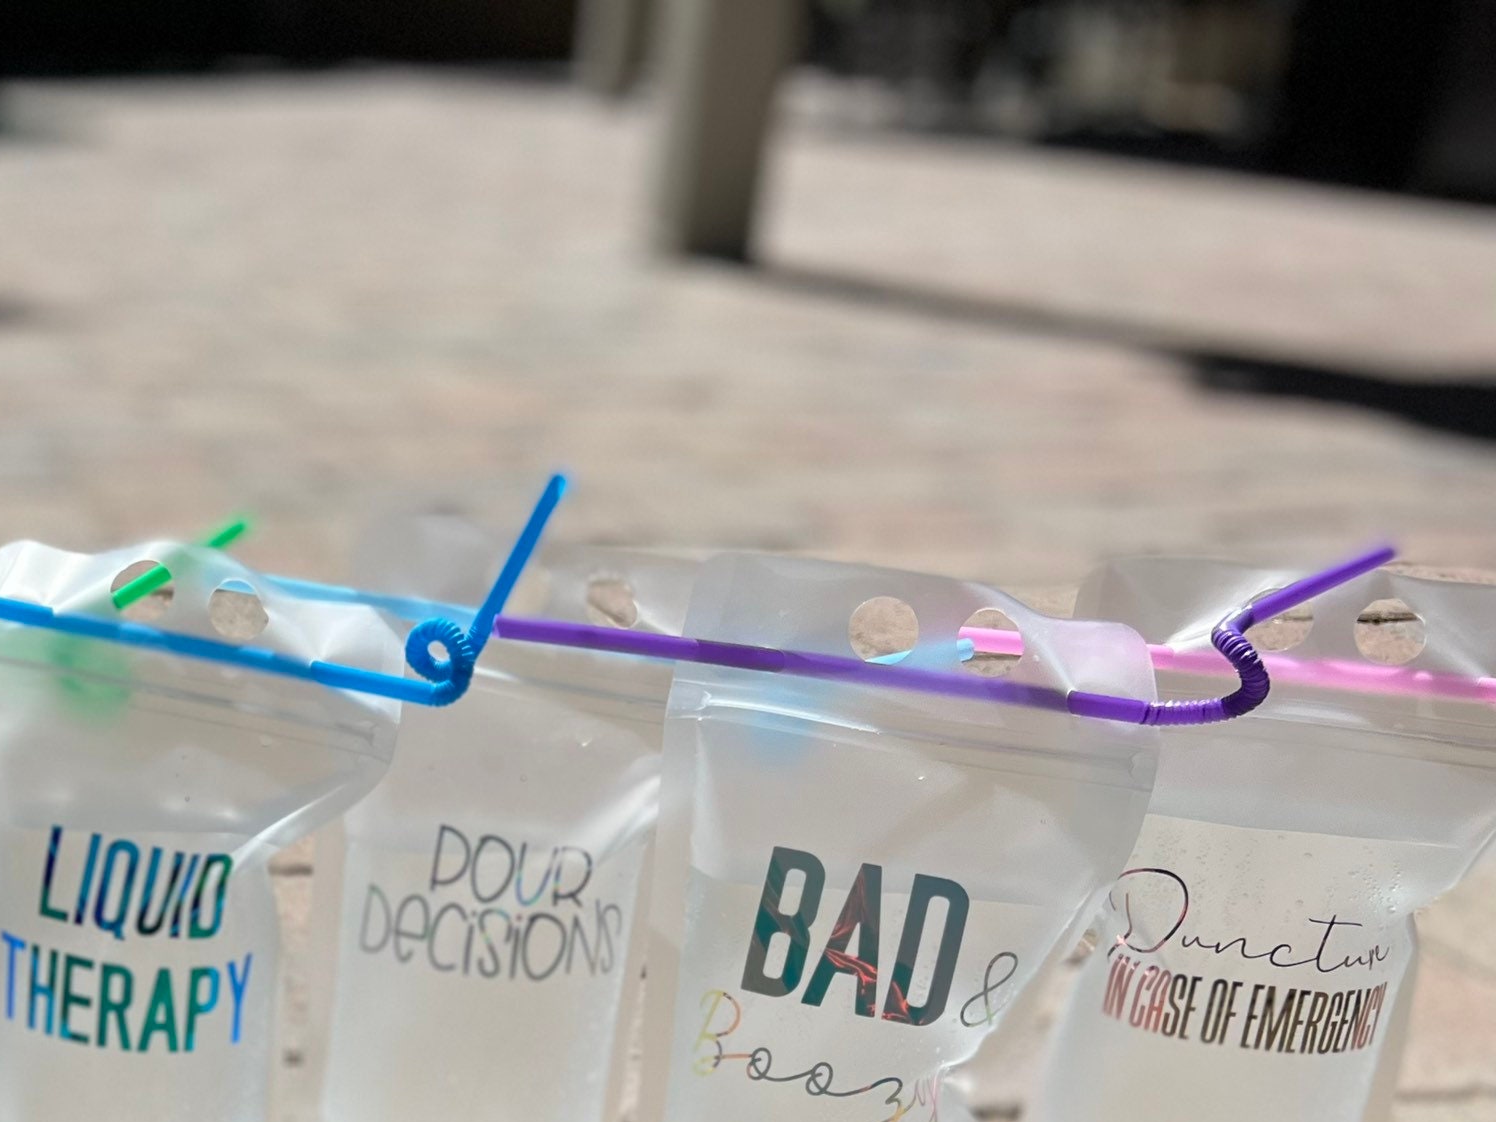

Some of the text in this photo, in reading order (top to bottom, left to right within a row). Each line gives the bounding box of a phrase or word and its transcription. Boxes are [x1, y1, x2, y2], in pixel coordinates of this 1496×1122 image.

[39, 825, 233, 941] LIQUID
[740, 846, 1019, 1028] BAD &
[0, 929, 253, 1054] THERAPY
[1102, 953, 1388, 1055] IN CASE OF EMERGENCY
